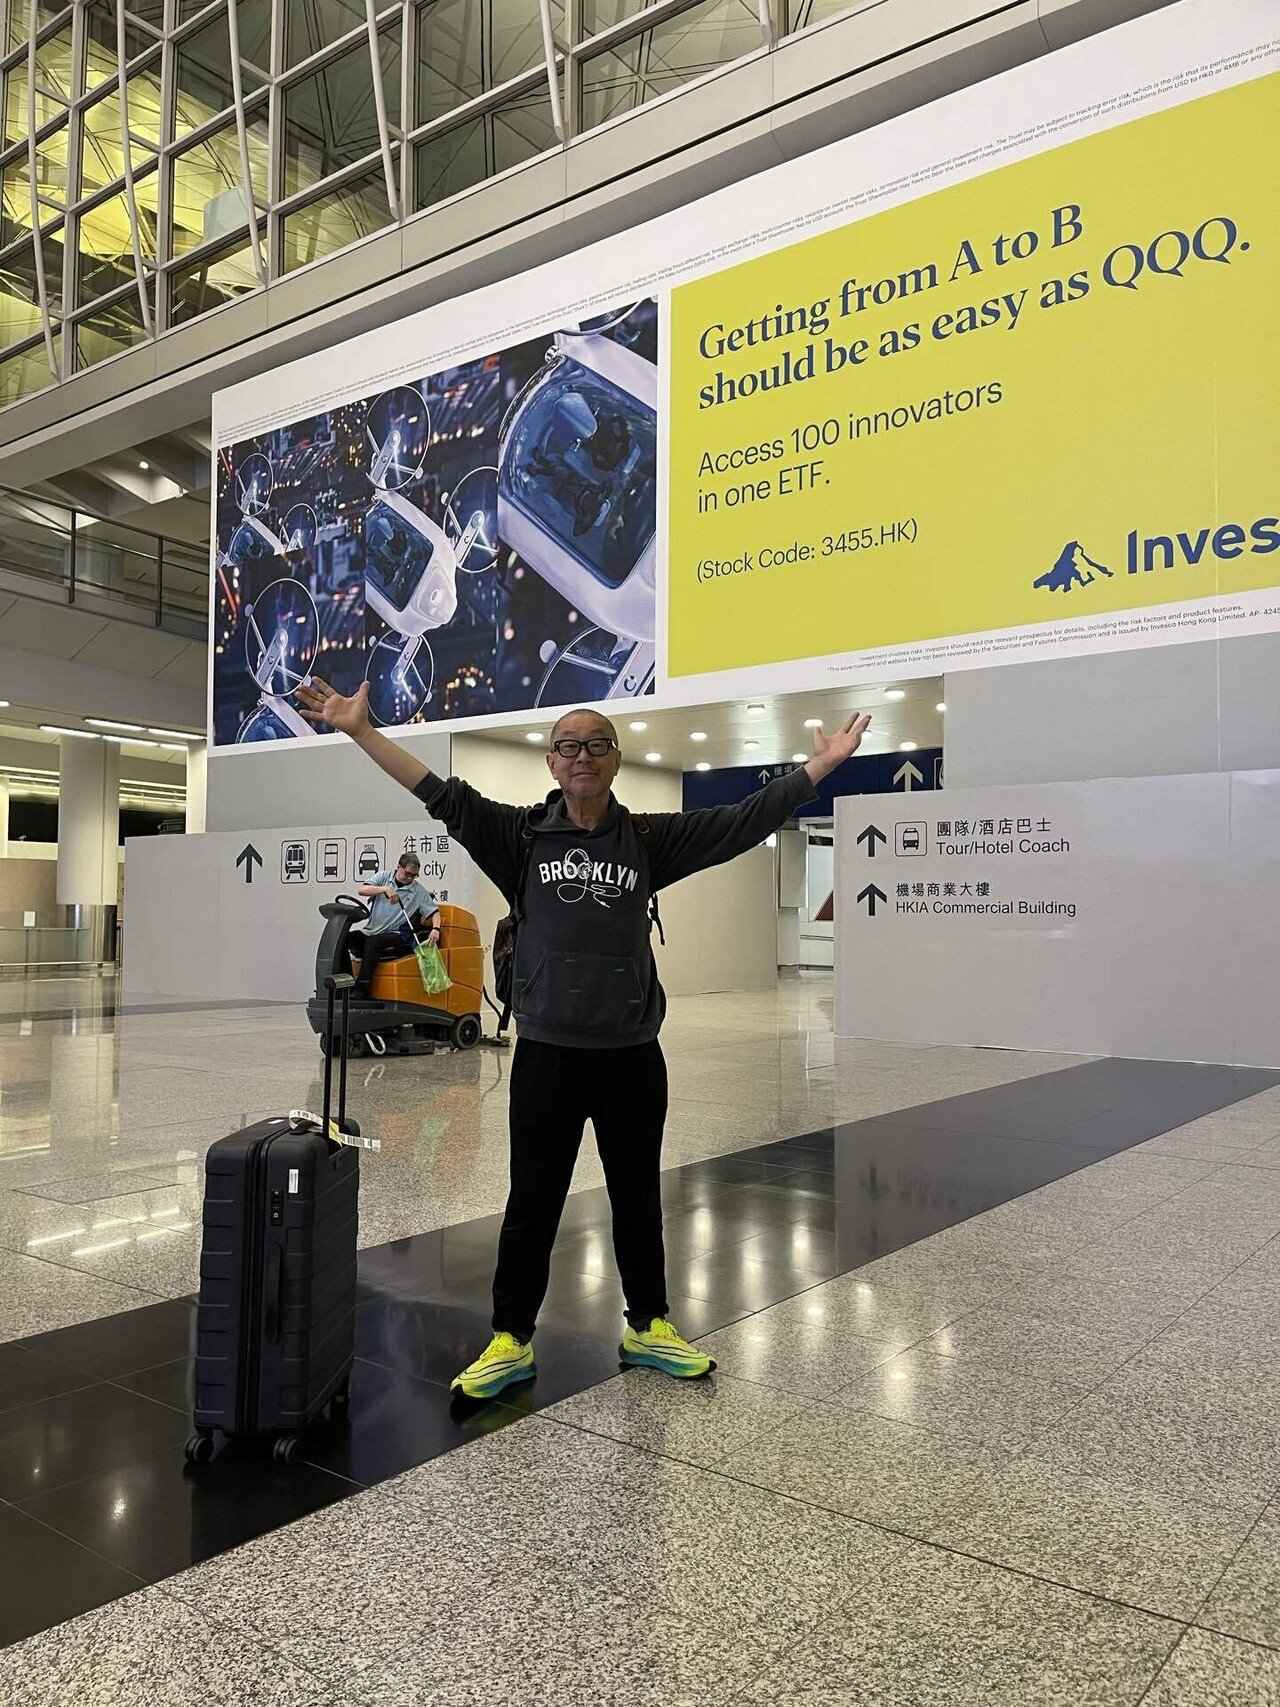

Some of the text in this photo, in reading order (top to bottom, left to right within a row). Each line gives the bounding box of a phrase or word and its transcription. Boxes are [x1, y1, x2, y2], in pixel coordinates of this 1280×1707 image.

[1046, 114, 1067, 127] subject
[1076, 103, 1101, 116] tracking
[1102, 98, 1117, 107] error
[1119, 92, 1131, 101] risk,
[1133, 84, 1152, 96] which
[1160, 78, 1171, 86] the
[1173, 72, 1184, 82] risk
[1185, 67, 1198, 77] that
[1210, 48, 1254, 70] performance
[1255, 42, 1270, 52] may
[1059, 114, 1092, 130] conversion
[1101, 104, 1116, 115] such
[1117, 91, 1156, 109] distributions
[1158, 85, 1173, 94] from
[1175, 78, 1189, 88] USD
[1199, 69, 1214, 80] HKD
[1224, 60, 1240, 71] RMB
[1250, 53, 1262, 62] any
[700, 204, 1083, 358] Getting from A to B
[700, 216, 1250, 410] should be as easy as QQQ.
[699, 382, 1003, 476] Access 100 innovators
[698, 460, 830, 513] in one ETF.
[697, 518, 918, 583] (Stock Code: 3455.HK)
[1128, 518, 1280, 574] Inves
[992, 642, 1021, 651] Securities
[1058, 632, 1096, 642] Commission
[1119, 626, 1139, 635] issued
[1141, 625, 1149, 633] by
[1150, 622, 1176, 630] Invesco
[1218, 611, 1247, 622] Limited.
[995, 634, 1018, 643] relevant
[1019, 630, 1052, 642] prospectus
[1064, 626, 1086, 634] details,
[1088, 622, 1117, 631] including
[1144, 615, 1167, 623] factors
[1183, 608, 1210, 620] product
[1212, 605, 1243, 614] features.
[404, 836, 450, 854] 往市區
[936, 818, 1051, 838] 團隊/酒店巴士
[936, 838, 1070, 856] Tour/Hotel Coach
[424, 860, 446, 880] city
[538, 860, 638, 892] BROOKLYN
[896, 882, 990, 898] 機場商業大樓
[896, 901, 1076, 918] HKIA Commercial Building
